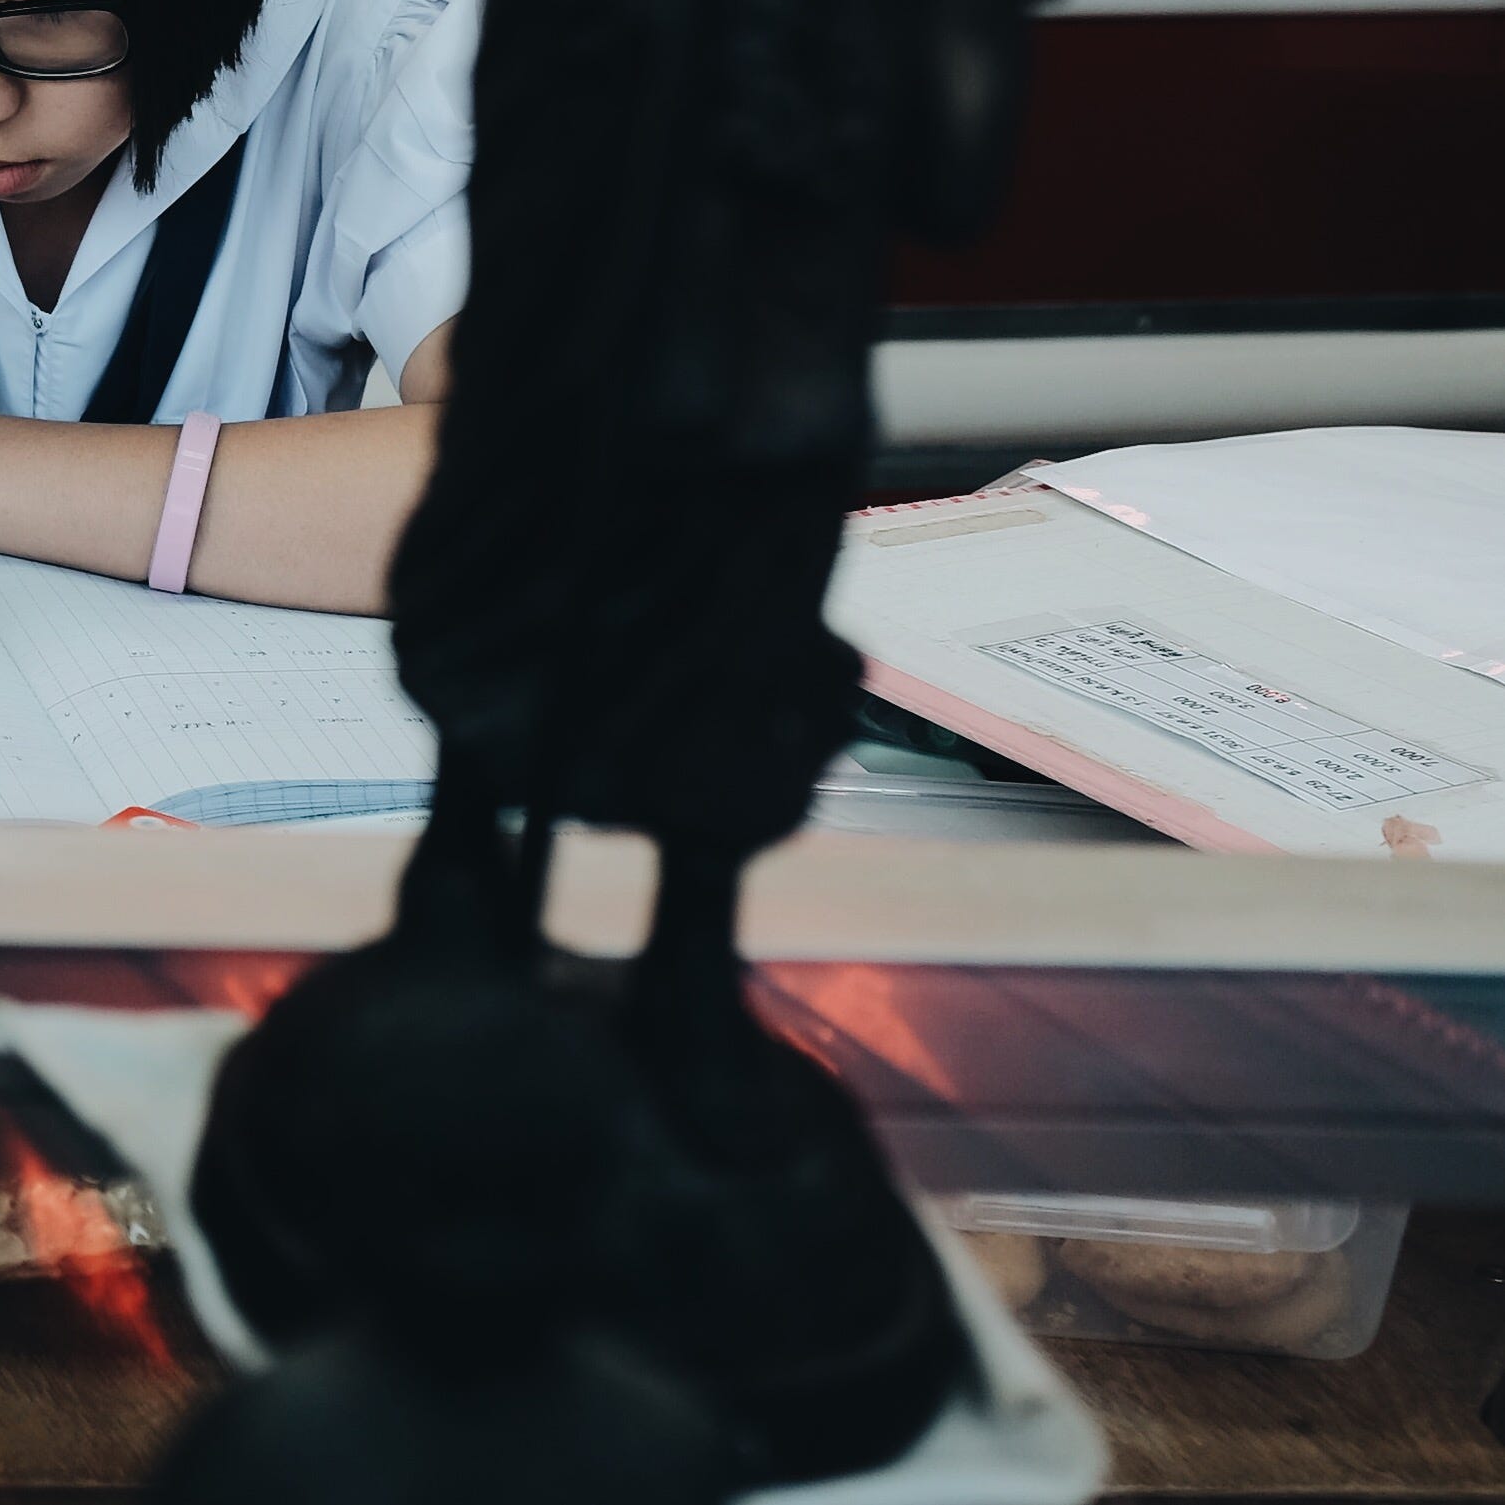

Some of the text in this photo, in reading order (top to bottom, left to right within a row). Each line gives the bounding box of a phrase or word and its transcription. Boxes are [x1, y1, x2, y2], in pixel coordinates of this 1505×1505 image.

[1172, 696, 1219, 715] 2,000
[1209, 691, 1255, 710] 3,500
[1353, 753, 1402, 774] 3,000
[1389, 747, 1440, 767] 7,000
[1315, 759, 1364, 780] 2,000
[1306, 780, 1353, 802] 27-29
